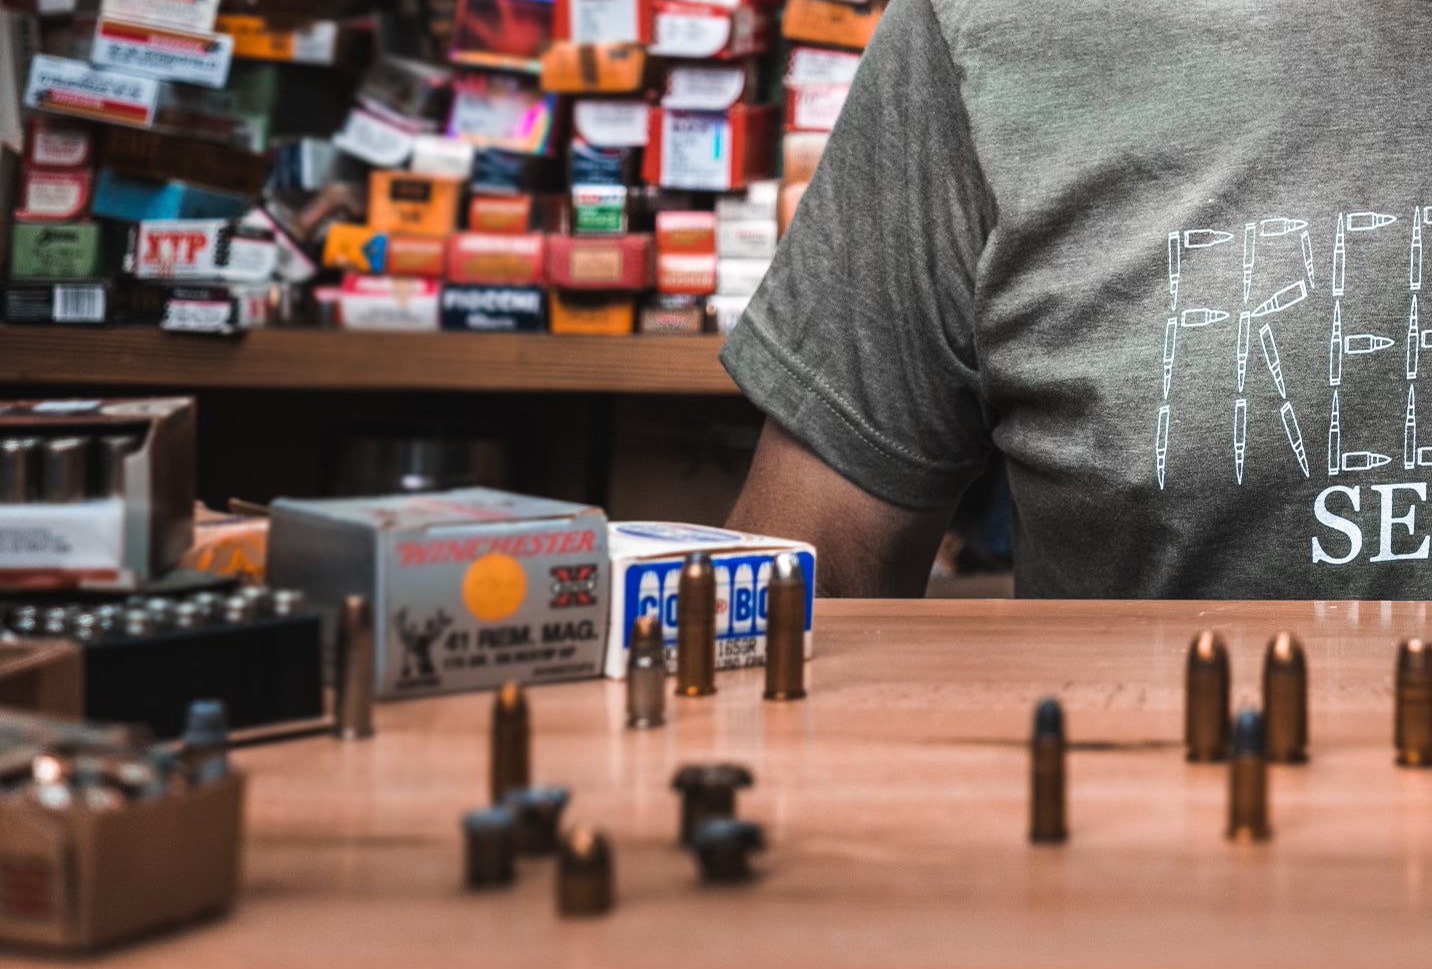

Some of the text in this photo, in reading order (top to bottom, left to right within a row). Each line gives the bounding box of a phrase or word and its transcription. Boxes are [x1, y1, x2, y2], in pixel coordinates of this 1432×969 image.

[396, 529, 596, 567] WINCHESTER
[445, 632, 469, 651] 41
[542, 619, 599, 644] MAG.
